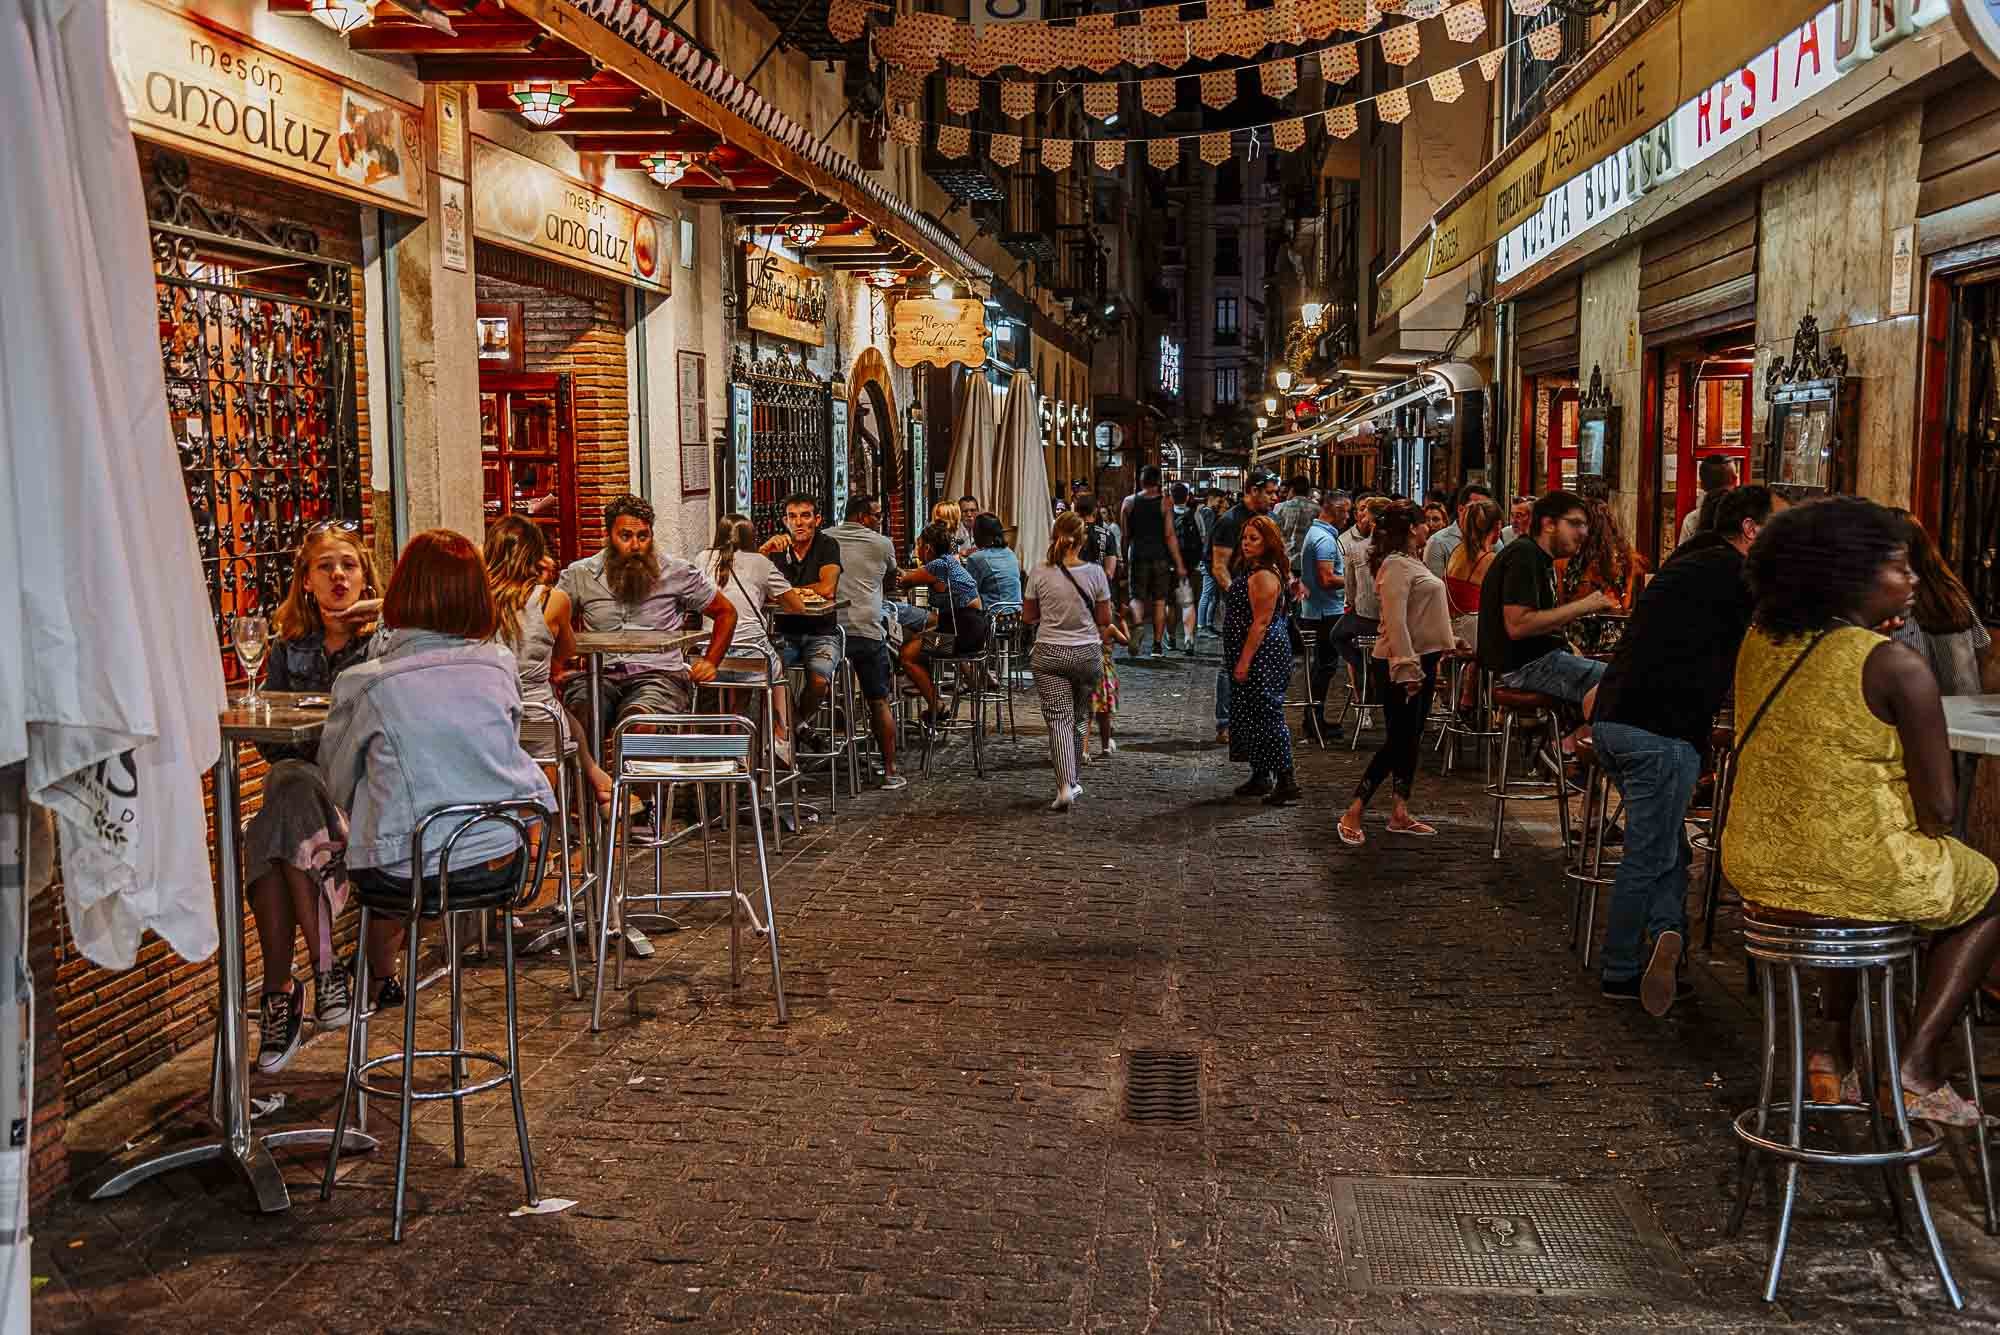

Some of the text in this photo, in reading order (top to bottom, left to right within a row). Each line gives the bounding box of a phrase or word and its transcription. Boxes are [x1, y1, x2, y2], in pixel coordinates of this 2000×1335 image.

[146, 71, 332, 172] andaluz
[1553, 61, 1646, 175] RESTAURANTE
[546, 213, 629, 266] andaluz
[1521, 187, 1571, 261] NUEVA
[1584, 120, 1673, 221] BODEGA
